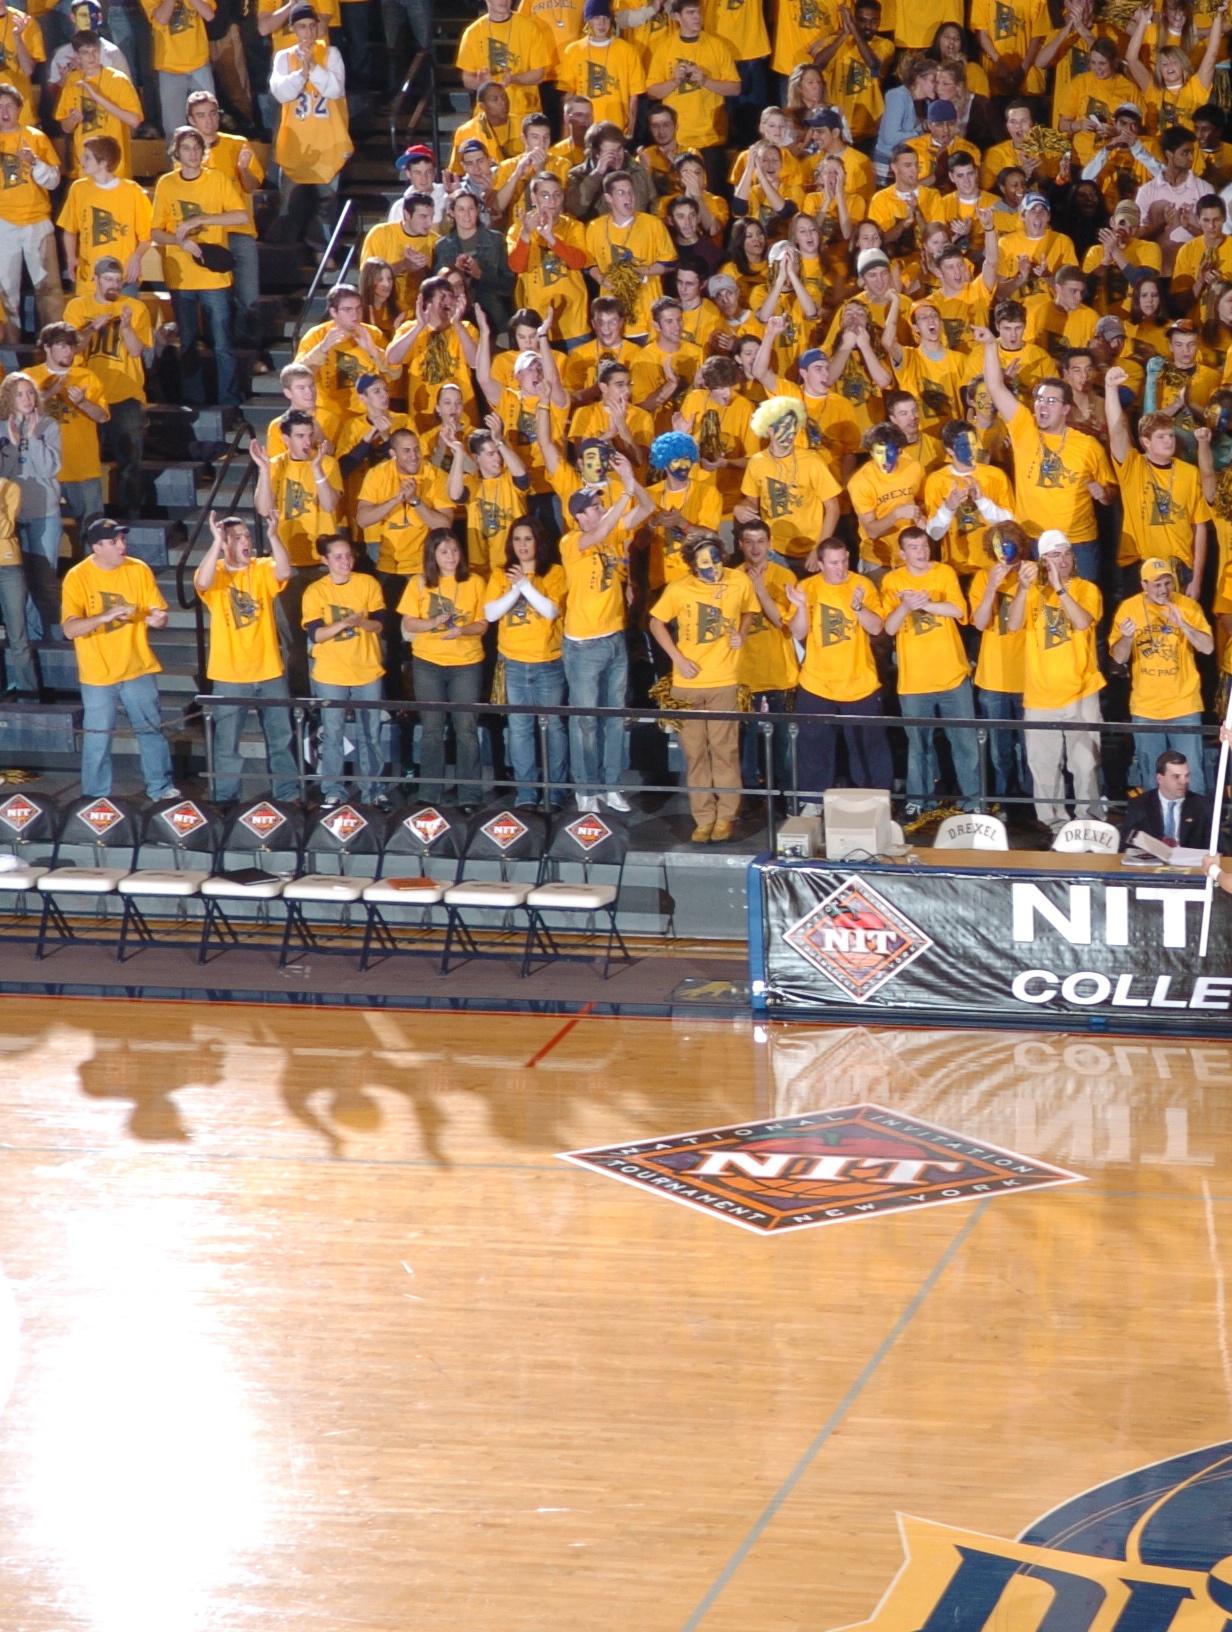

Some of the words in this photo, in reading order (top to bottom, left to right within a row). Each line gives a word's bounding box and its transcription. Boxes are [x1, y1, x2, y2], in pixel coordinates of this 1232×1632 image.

[294, 92, 328, 118] 32
[7, 808, 31, 818] NIT
[89, 811, 114, 821] NIT
[173, 813, 198, 824] NIT
[252, 815, 276, 825] NIT
[493, 825, 518, 835] NIT
[577, 826, 602, 837] NIT
[948, 821, 996, 841] DREXEL
[1065, 828, 1113, 849] DREXEL
[1012, 882, 1213, 948] NIT
[820, 927, 898, 955] NIT
[617, 1114, 843, 1155] NATIONAL
[870, 1115, 1034, 1174] INVITATION
[684, 1150, 966, 1186] NIT
[606, 1159, 768, 1222] TOURNAMENT
[793, 1203, 875, 1224] NEW
[909, 1179, 1021, 1202] YORK
